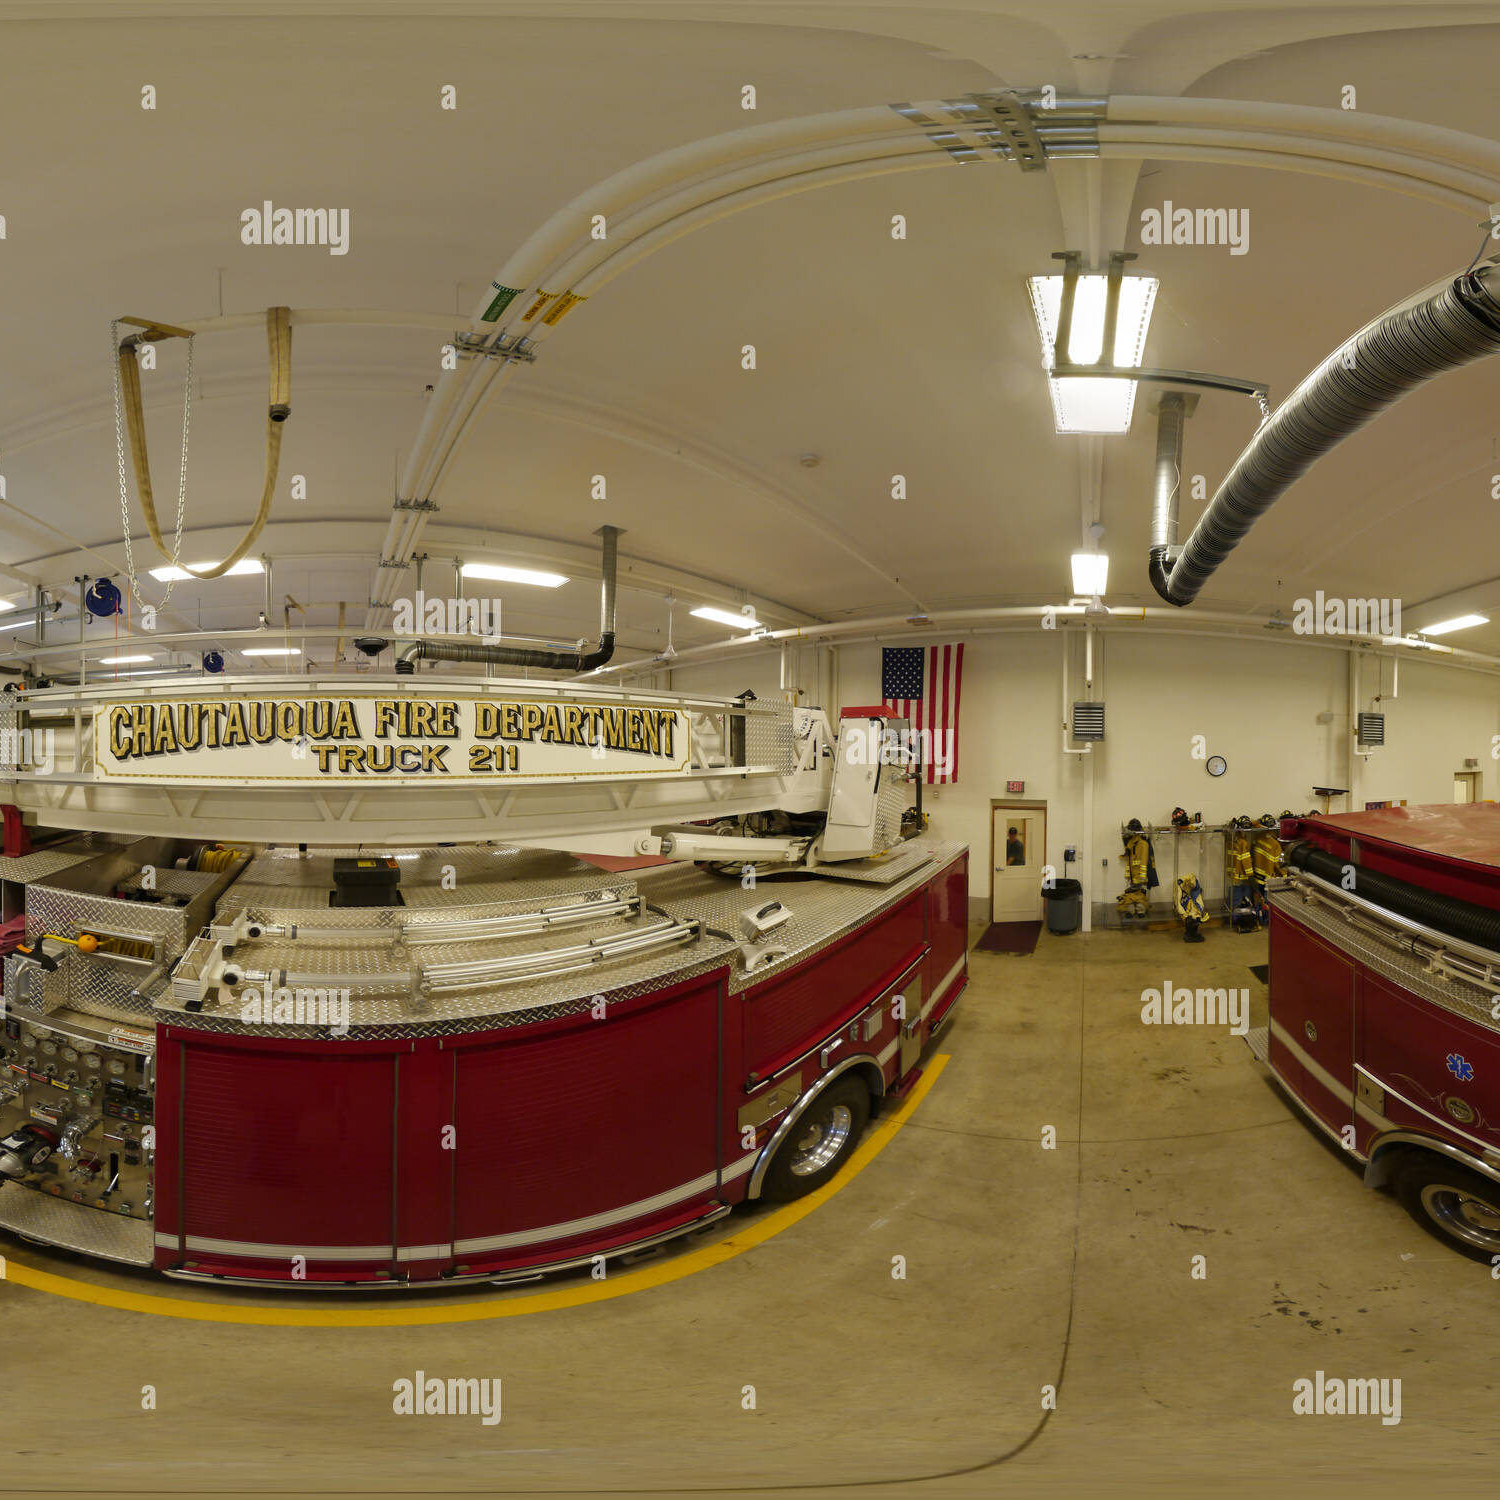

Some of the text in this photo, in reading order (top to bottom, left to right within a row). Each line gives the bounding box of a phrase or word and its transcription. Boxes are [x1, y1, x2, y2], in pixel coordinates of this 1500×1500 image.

[108, 700, 678, 761] CHAUTAUQUA FIRE DEPARTMENT
[311, 744, 520, 773] TRUCK 211
[1009, 781, 1024, 792] EXIT
